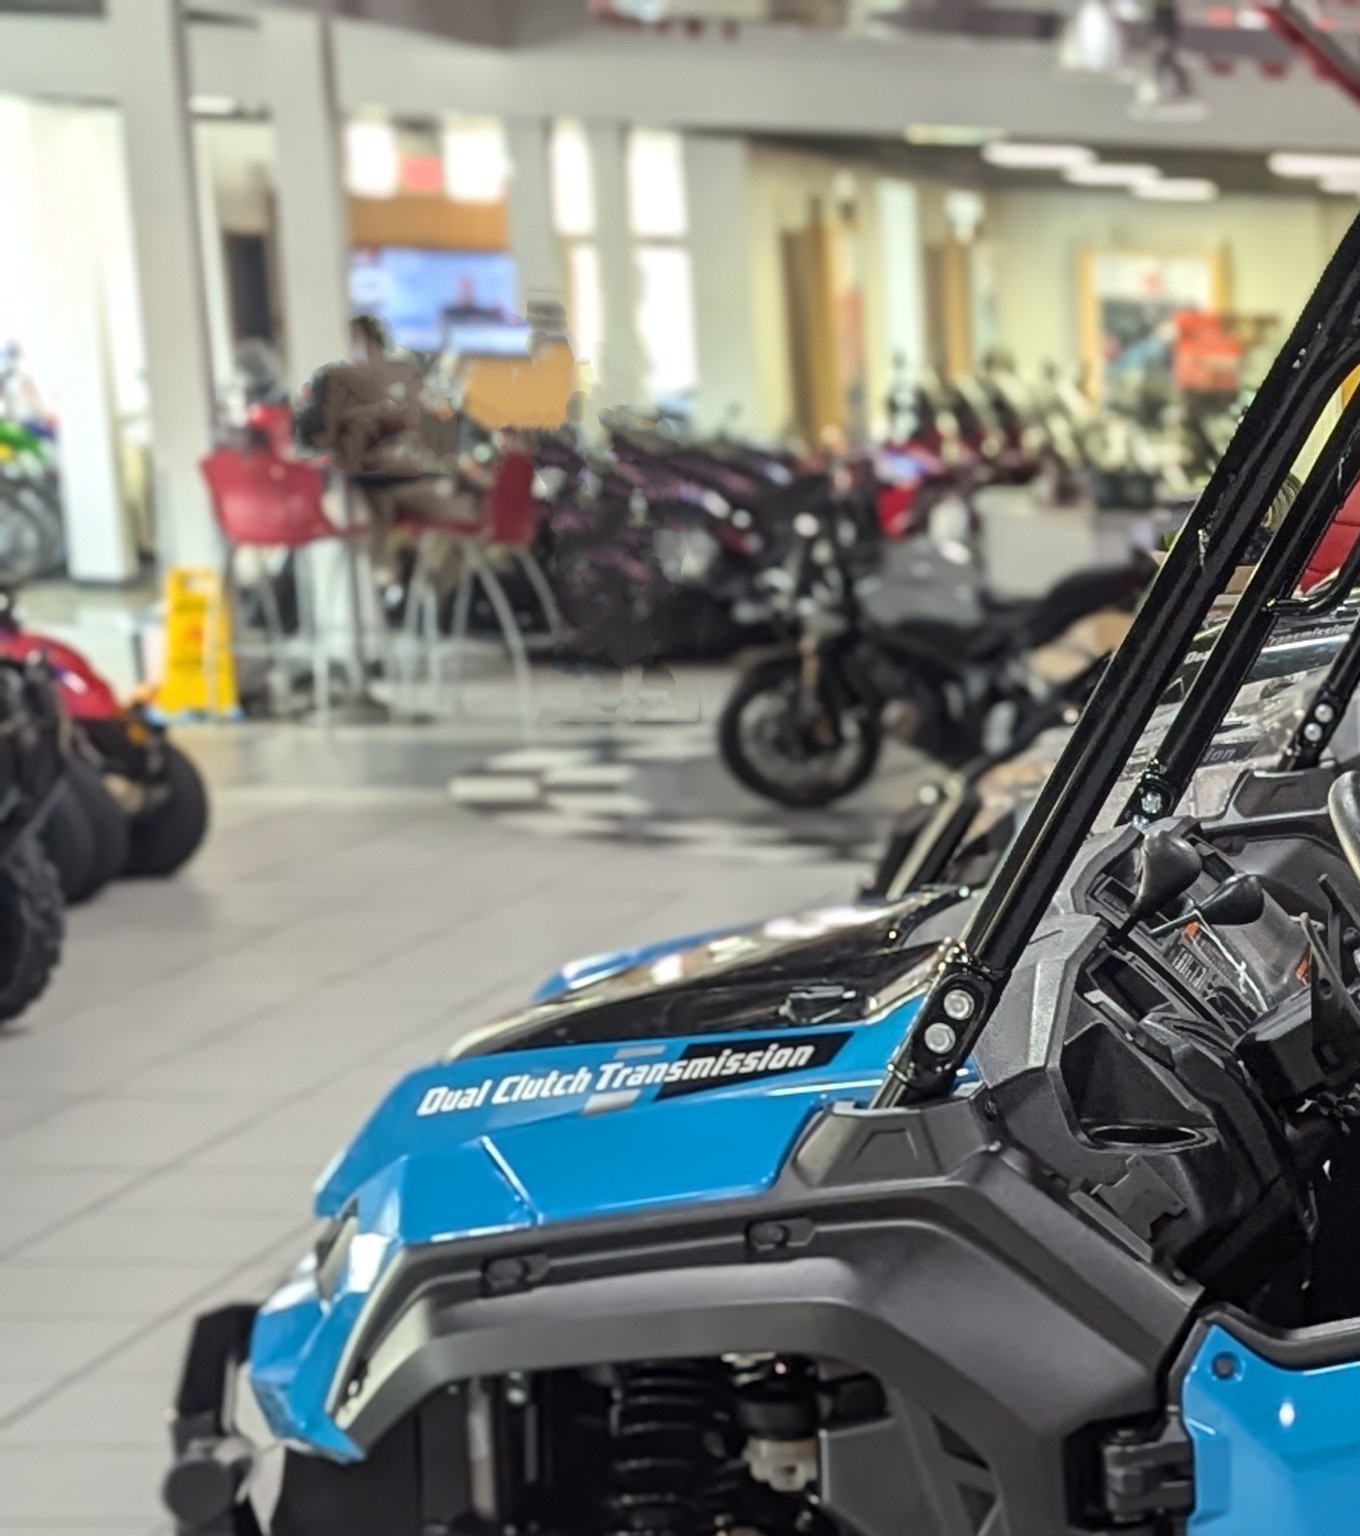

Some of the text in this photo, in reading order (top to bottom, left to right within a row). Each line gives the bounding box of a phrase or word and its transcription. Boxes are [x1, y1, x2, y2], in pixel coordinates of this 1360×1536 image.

[417, 1043, 816, 1116] Dual Clutch Transmission
